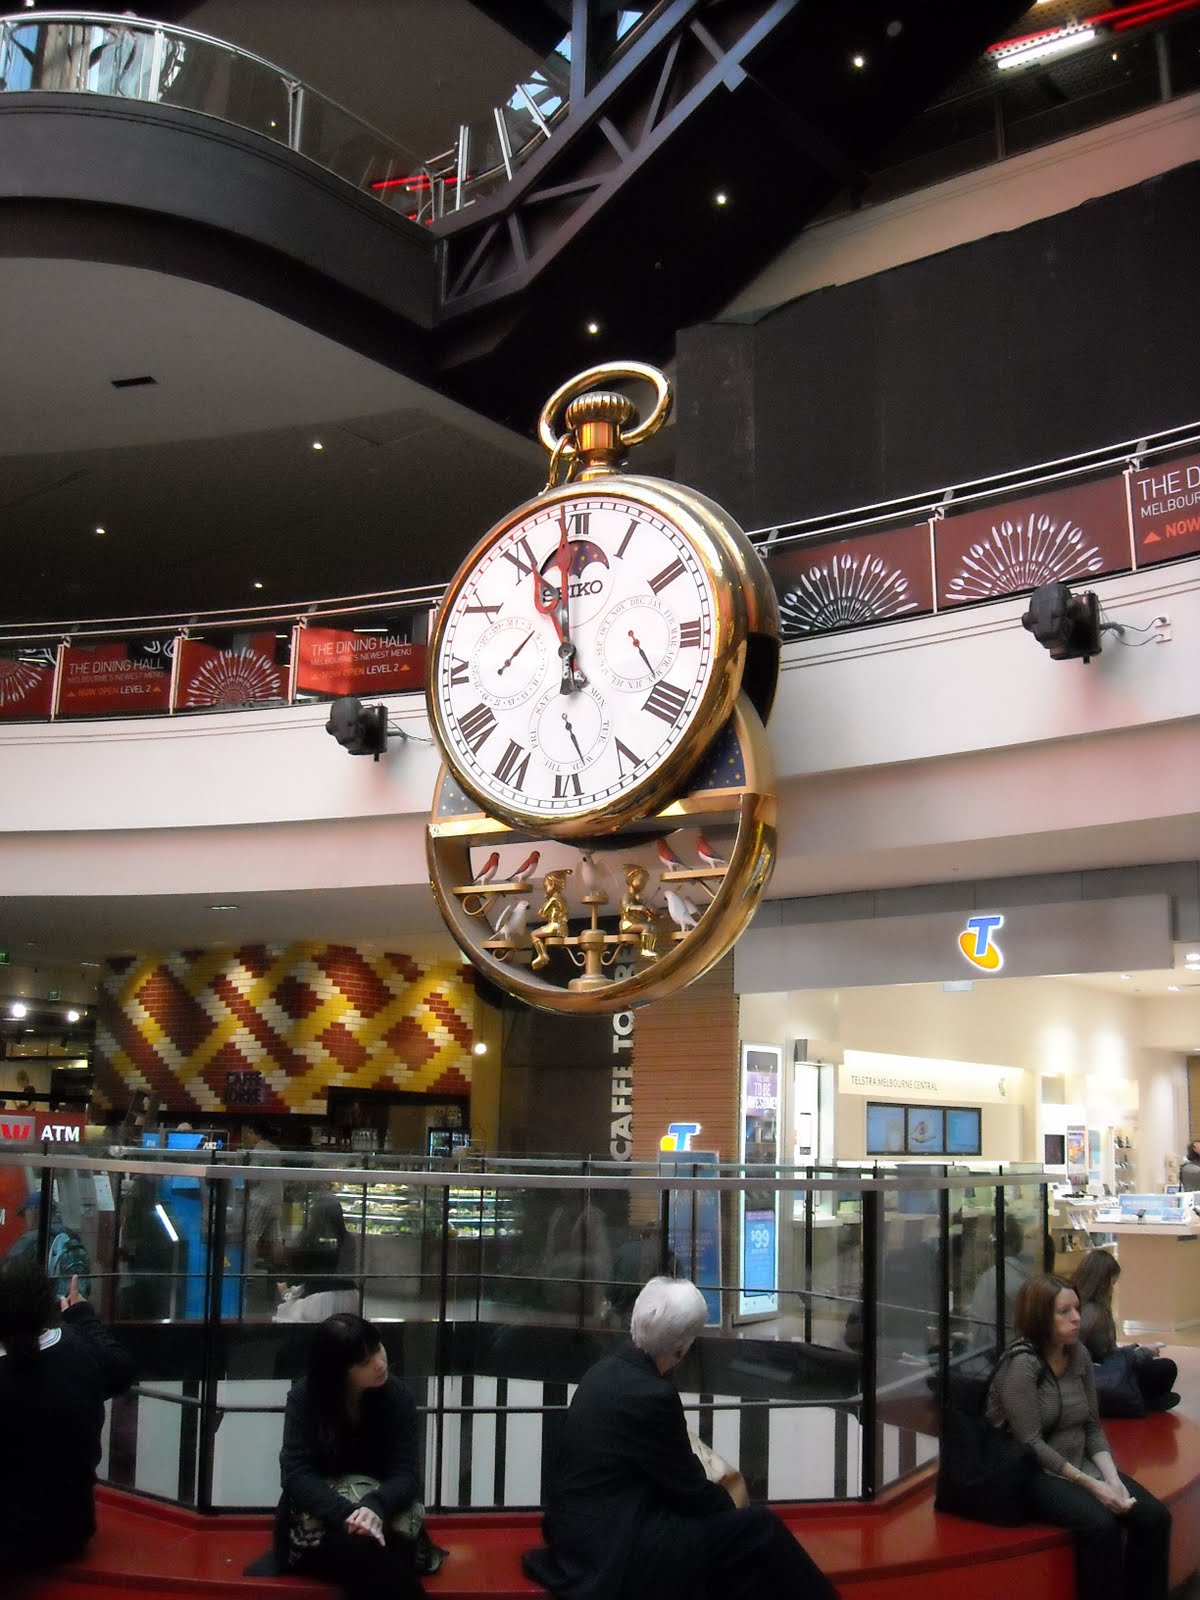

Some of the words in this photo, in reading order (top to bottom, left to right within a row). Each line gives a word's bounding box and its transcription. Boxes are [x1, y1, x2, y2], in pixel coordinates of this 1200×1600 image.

[1137, 470, 1182, 500] THE
[1166, 516, 1200, 538] NOW
[542, 580, 603, 602] SEIKO
[680, 616, 701, 648] III
[312, 642, 334, 656] THE
[336, 637, 377, 654] DINING
[380, 634, 412, 649] HALL
[360, 650, 389, 660] NEWEST
[391, 648, 412, 657] MENU
[69, 662, 90, 675] THE
[92, 659, 131, 674] DINING
[134, 658, 164, 670] HALL
[344, 667, 365, 676] OPEN
[366, 664, 392, 675] LEVEL
[394, 663, 399, 672] 2
[120, 685, 144, 694] LEVEL
[146, 684, 151, 692] 2
[851, 1076, 876, 1086] TELSTRA
[878, 1078, 912, 1088] MELBOURNE
[914, 1080, 938, 1090] CENTRAL
[610, 1066, 633, 1162] CAFFE
[41, 1124, 80, 1142] ATM
[202, 1142, 218, 1150] ANZ
